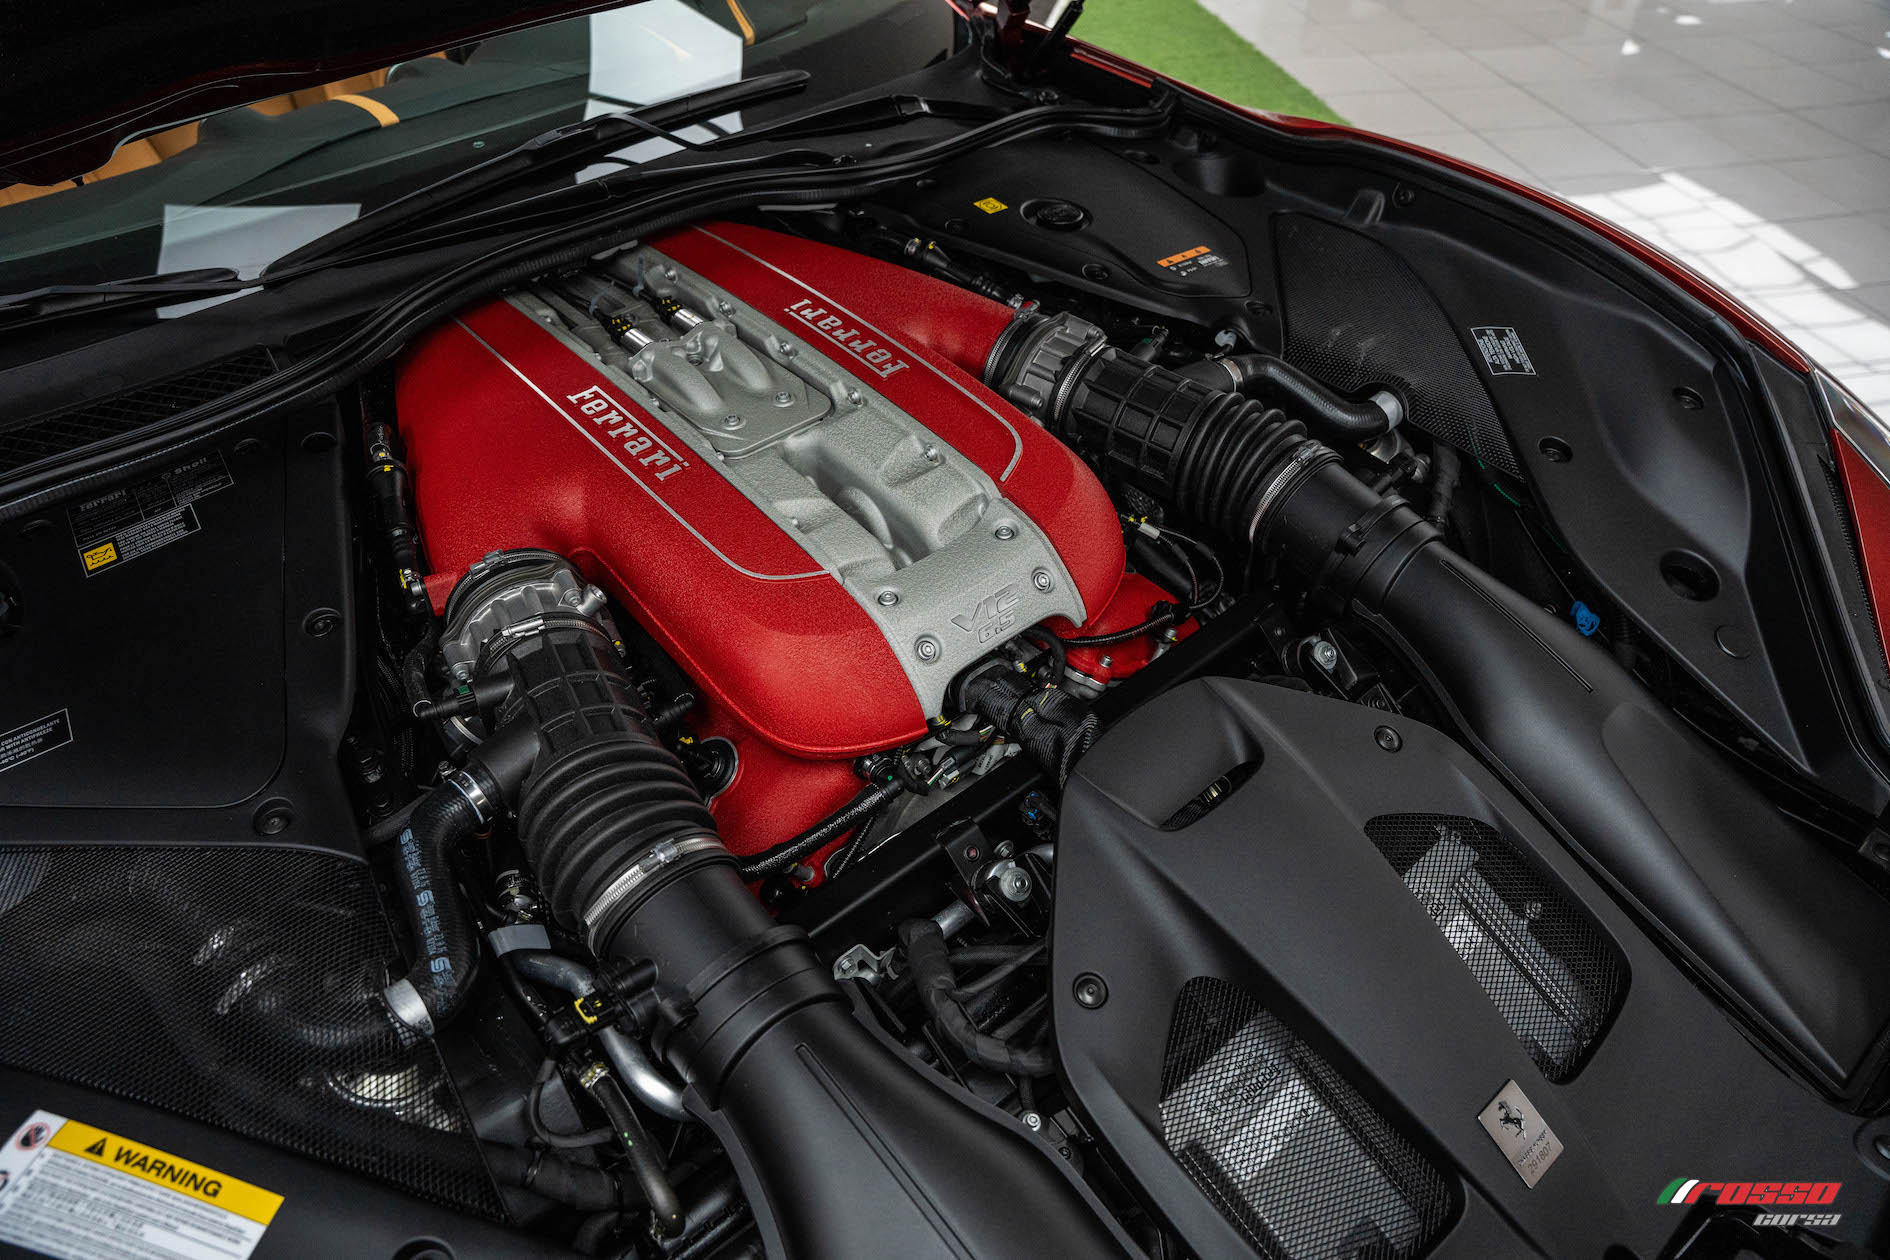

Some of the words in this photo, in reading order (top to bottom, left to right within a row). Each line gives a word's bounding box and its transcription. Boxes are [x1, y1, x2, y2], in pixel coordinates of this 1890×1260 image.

[784, 299, 909, 378] Ferrari
[567, 385, 691, 481] Ferrari
[174, 456, 208, 475] Shell
[79, 488, 127, 512] Ferrari
[950, 583, 1020, 632] V12
[977, 609, 1016, 643] 6.5
[114, 1147, 223, 1199] WARNING
[1527, 1142, 1552, 1174] 291807
